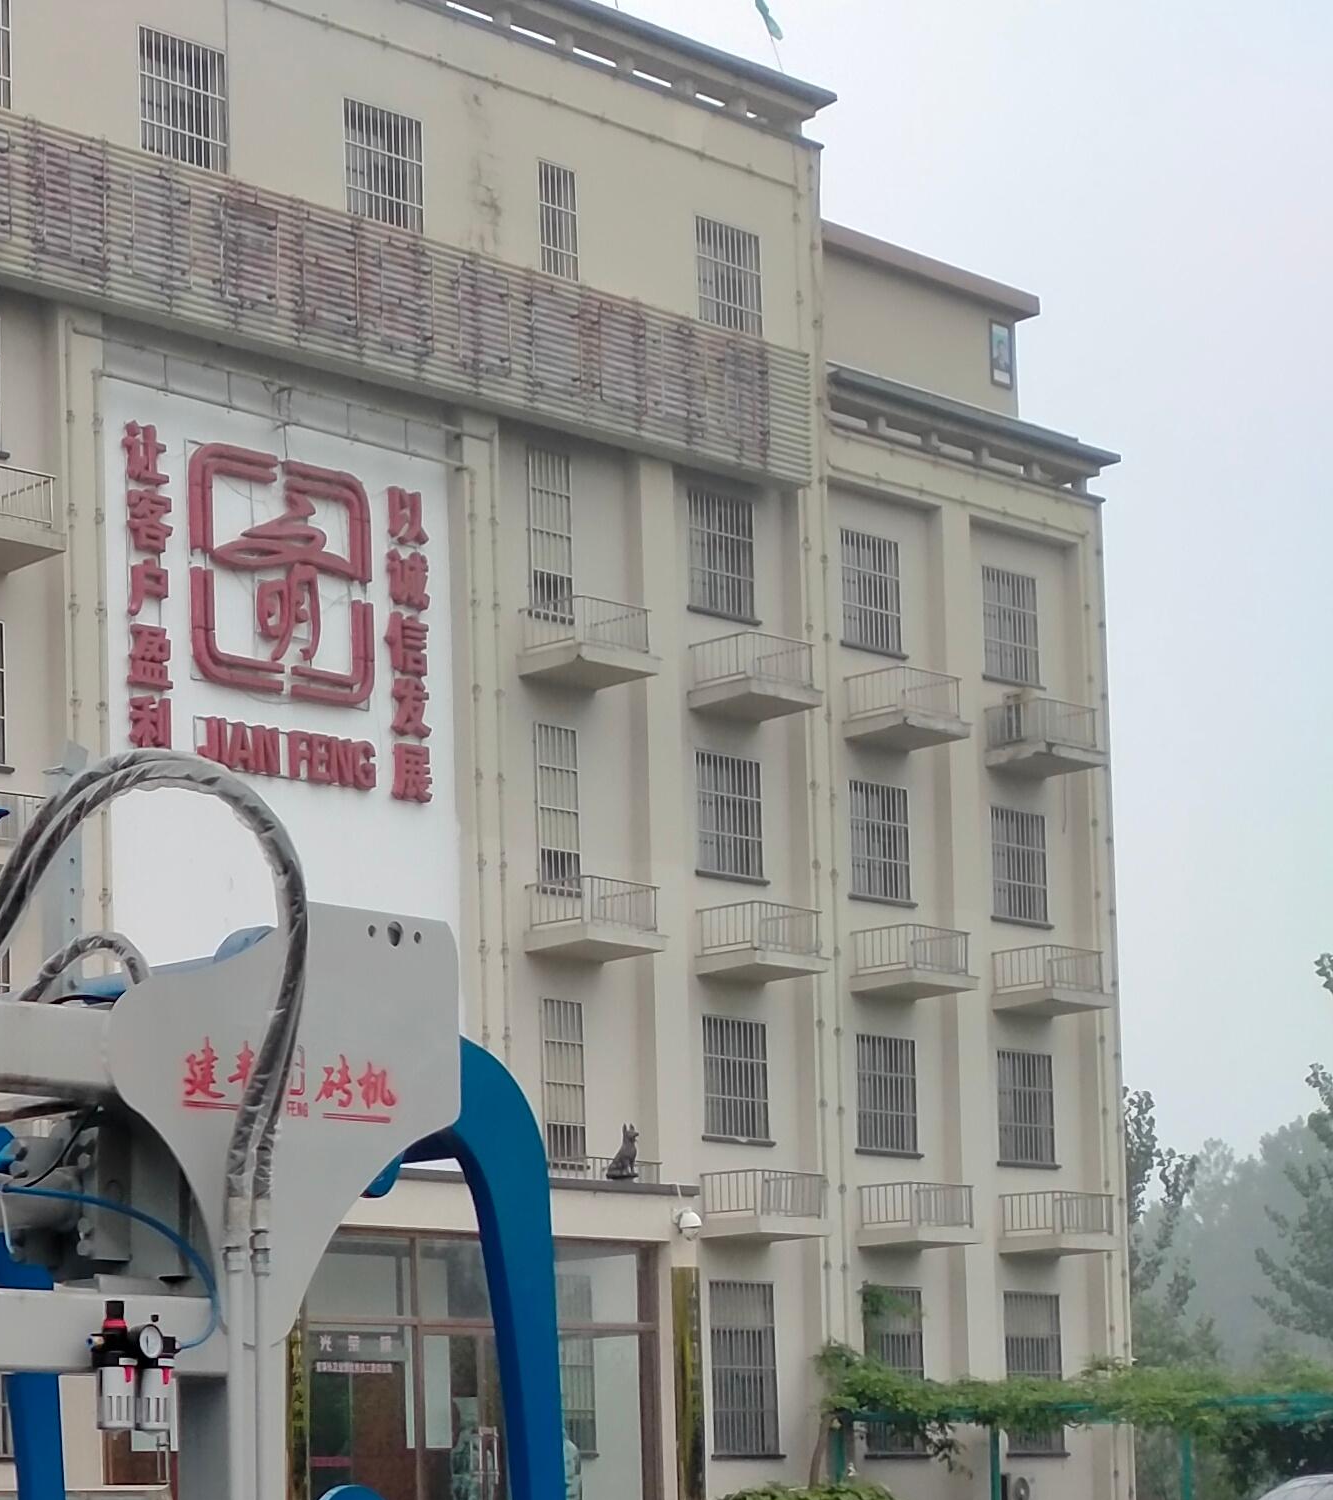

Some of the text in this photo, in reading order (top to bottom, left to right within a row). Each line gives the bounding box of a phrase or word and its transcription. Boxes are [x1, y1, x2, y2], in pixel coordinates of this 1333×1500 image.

[123, 420, 173, 748] 让客户盈利
[385, 485, 433, 804] 以诚信发展
[197, 716, 377, 791] JIAN FENG
